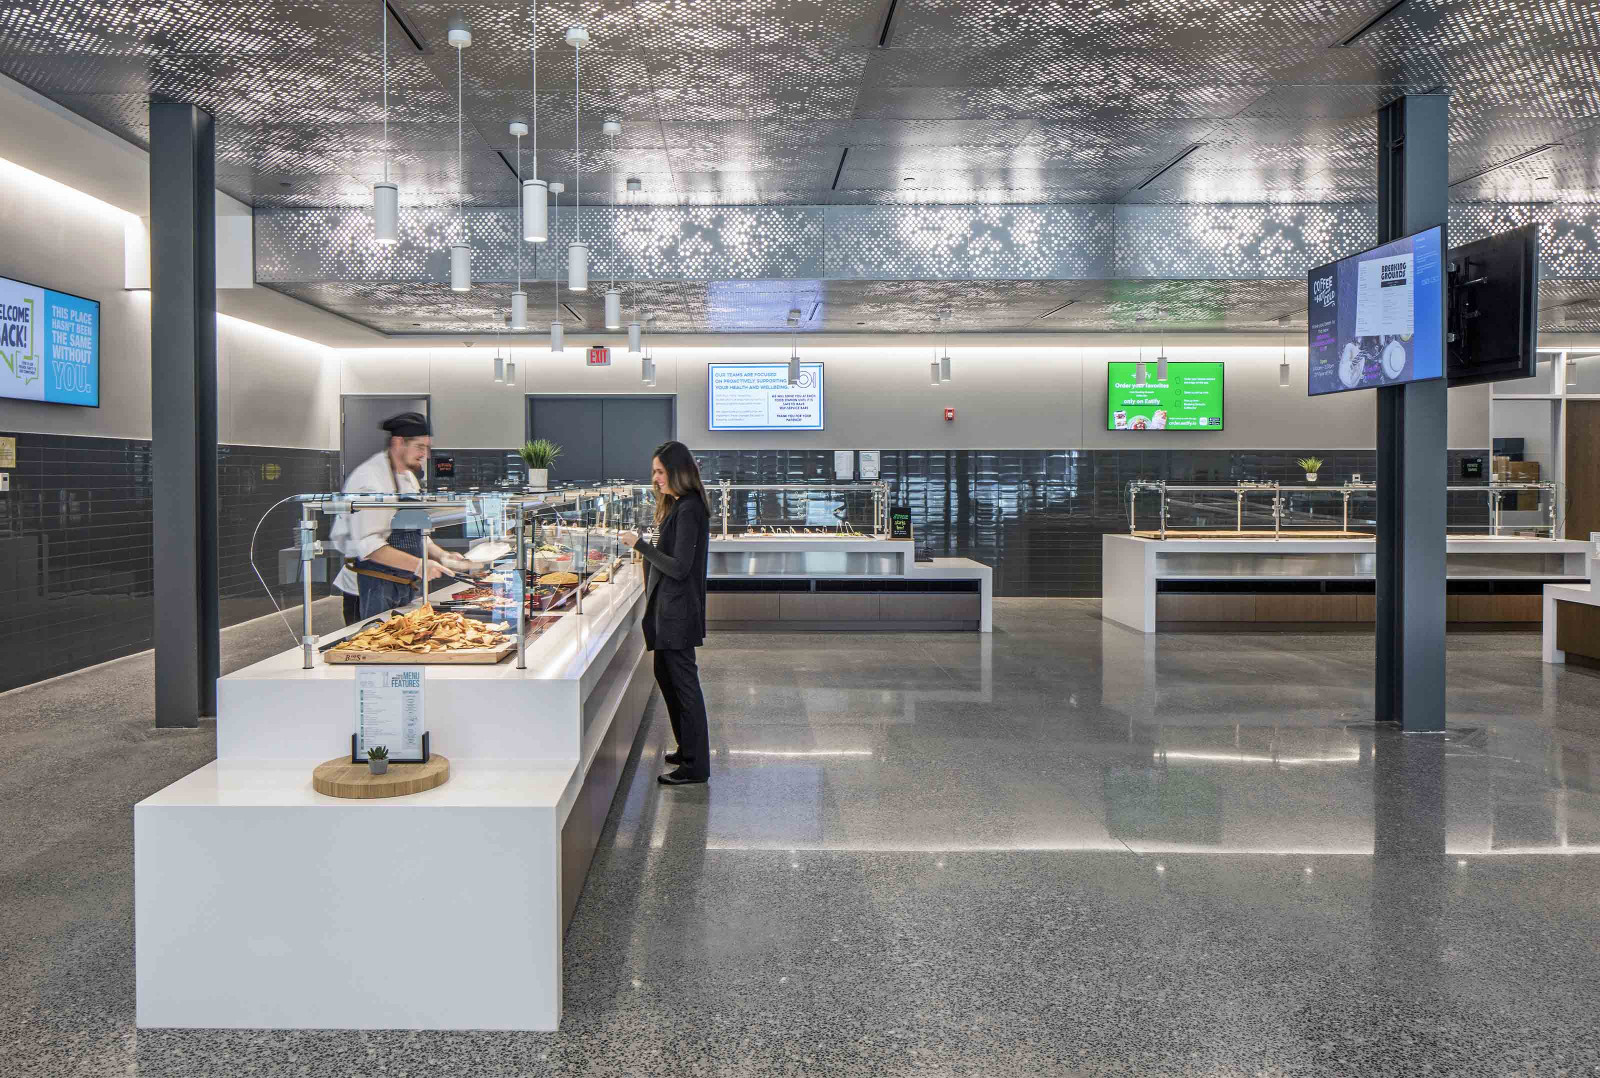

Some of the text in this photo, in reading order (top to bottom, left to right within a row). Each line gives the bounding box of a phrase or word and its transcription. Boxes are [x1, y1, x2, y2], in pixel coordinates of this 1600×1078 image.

[1381, 270, 1406, 280] GROUNDS
[1382, 262, 1406, 272] BREAKING
[1314, 276, 1333, 294] COFFEE
[0, 304, 30, 323] ELCOME
[52, 305, 92, 324] THIS PLACE
[0, 323, 27, 348] ACK!
[52, 318, 92, 336] HASN'T BEEN
[52, 330, 92, 350] THE SAME
[52, 344, 92, 364] WITHOUT
[590, 350, 608, 363] EXIT
[403, 672, 420, 680] MENU
